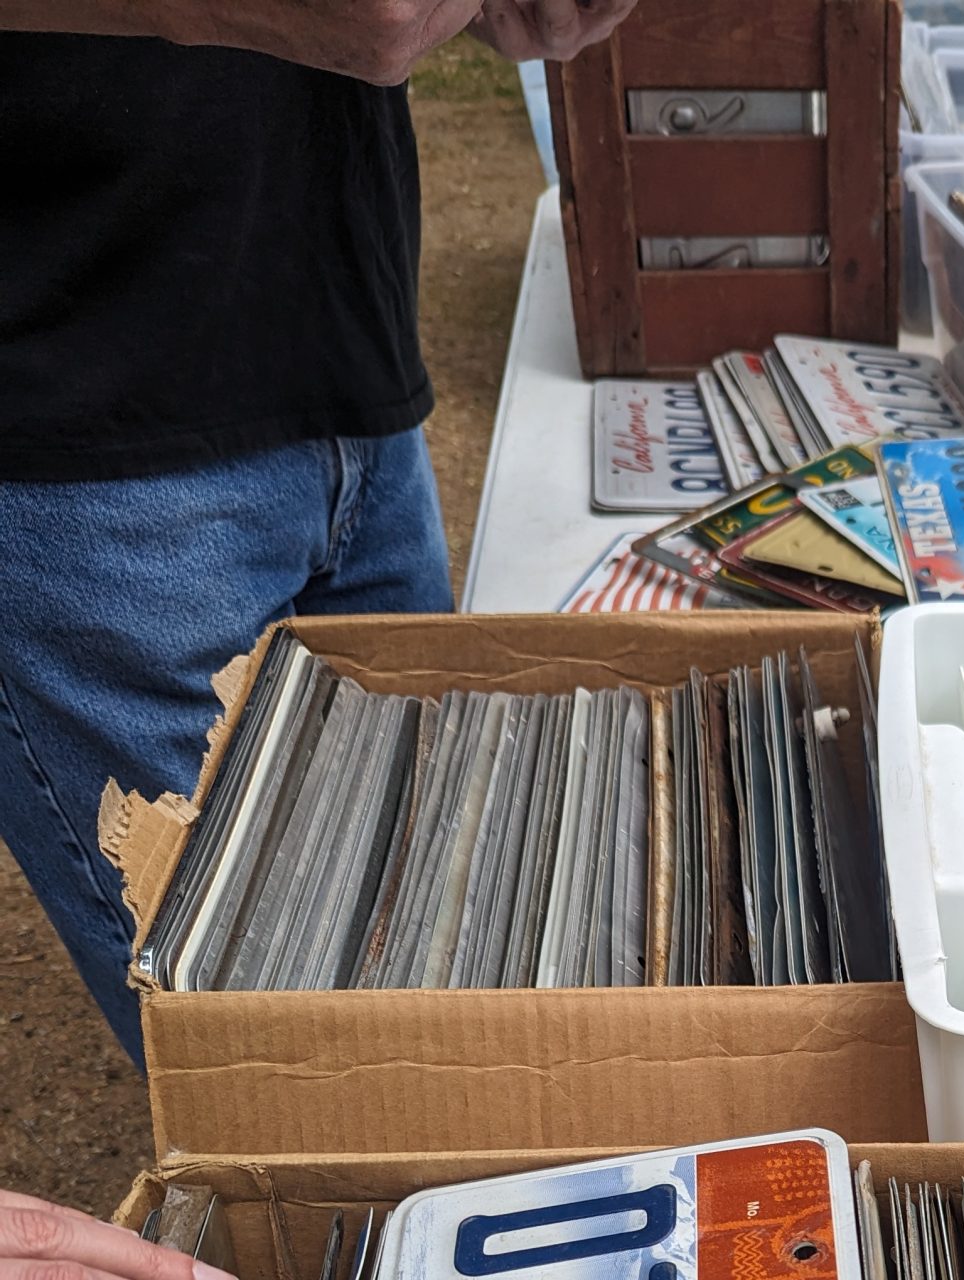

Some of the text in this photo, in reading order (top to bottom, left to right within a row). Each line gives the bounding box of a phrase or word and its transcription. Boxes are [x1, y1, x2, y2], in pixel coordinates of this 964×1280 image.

[611, 396, 664, 474] California
[901, 481, 960, 558] TEXAS
[747, 1201, 760, 1220] Mo.
